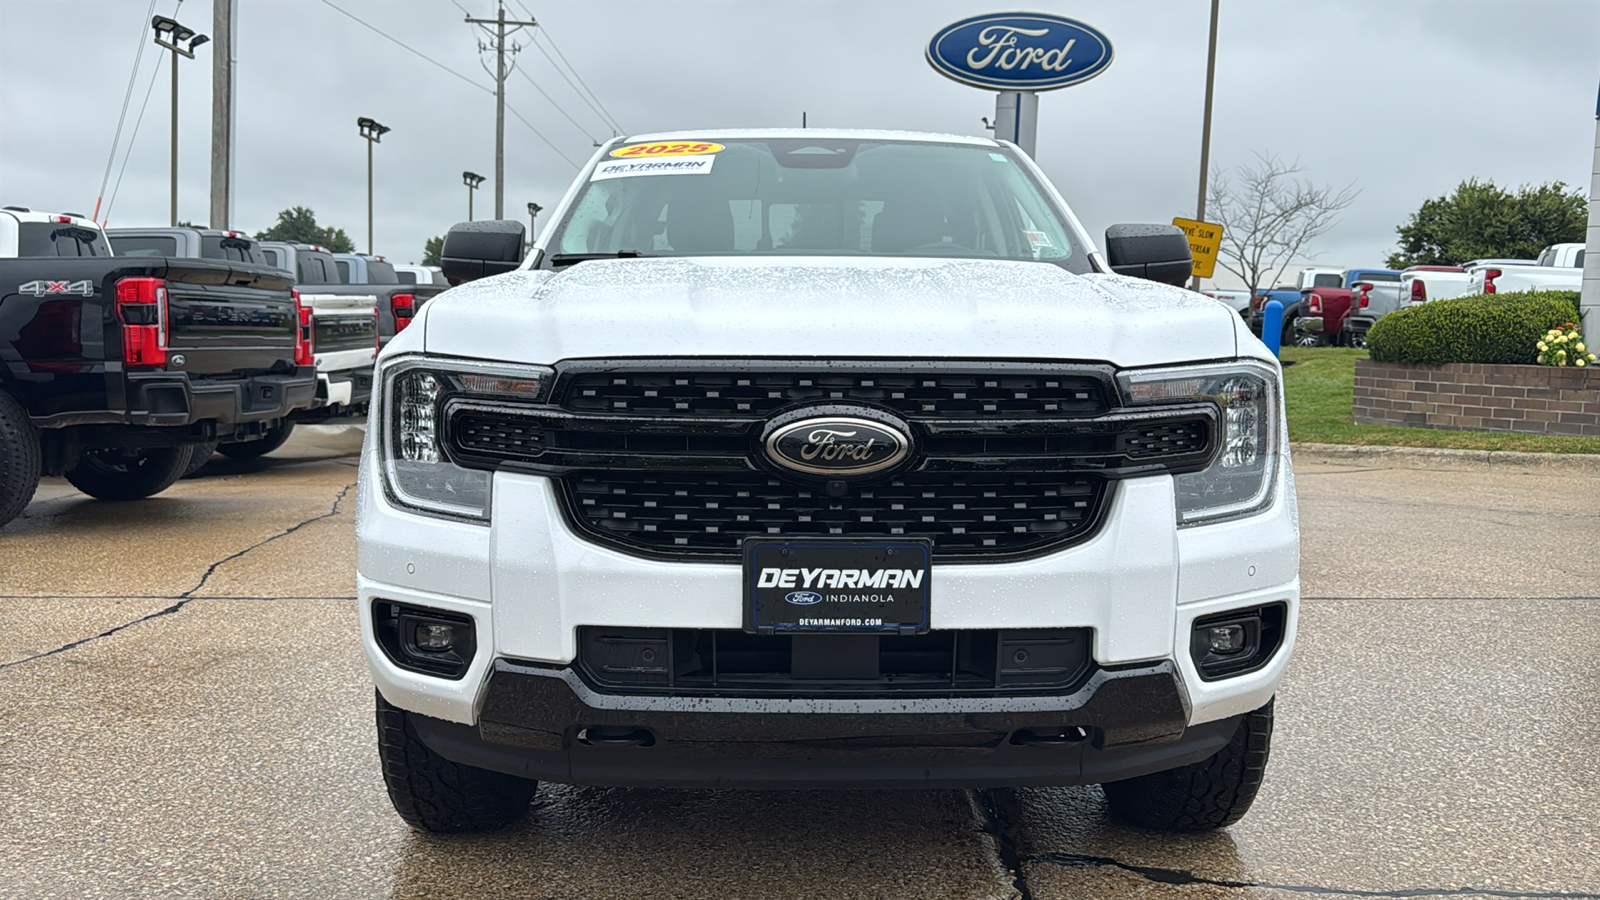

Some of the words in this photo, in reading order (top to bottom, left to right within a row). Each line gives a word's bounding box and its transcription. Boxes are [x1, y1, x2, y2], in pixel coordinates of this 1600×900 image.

[967, 25, 1076, 71] Ford
[621, 144, 713, 156] 2025
[602, 161, 706, 173] DEYARMAN
[1198, 229, 1214, 239] SLOW
[800, 429, 875, 460] Ford
[757, 567, 924, 588] DEYARMAN
[792, 592, 815, 602] Ford
[826, 594, 894, 602] INDIANOLA
[799, 618, 882, 626] DEYARMANFORD.COM
